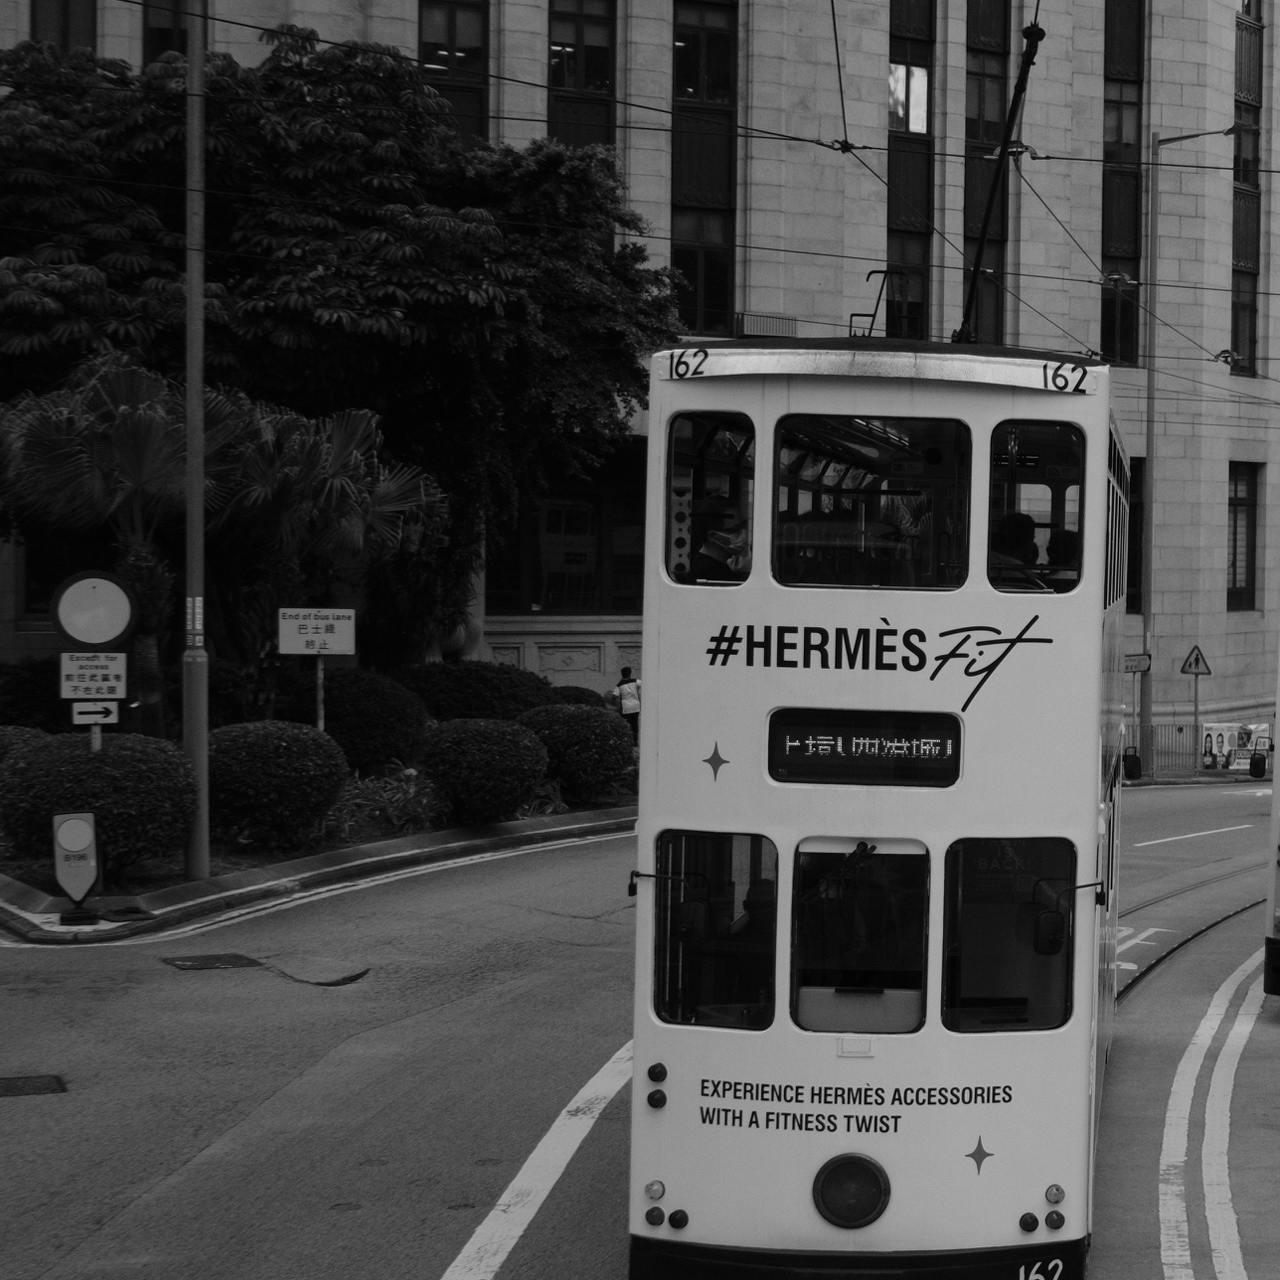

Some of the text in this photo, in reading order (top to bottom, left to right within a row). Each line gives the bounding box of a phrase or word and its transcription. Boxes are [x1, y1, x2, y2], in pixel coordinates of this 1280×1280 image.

[670, 349, 709, 380] 162
[1043, 361, 1088, 395] 162
[281, 612, 352, 621] End of bus lane
[706, 616, 927, 672] #HERMÈS
[700, 1079, 1014, 1106] EXPERIENCE HERMÈS ACCESSORIES
[699, 1106, 902, 1134] WITH A FITNESS TWIST
